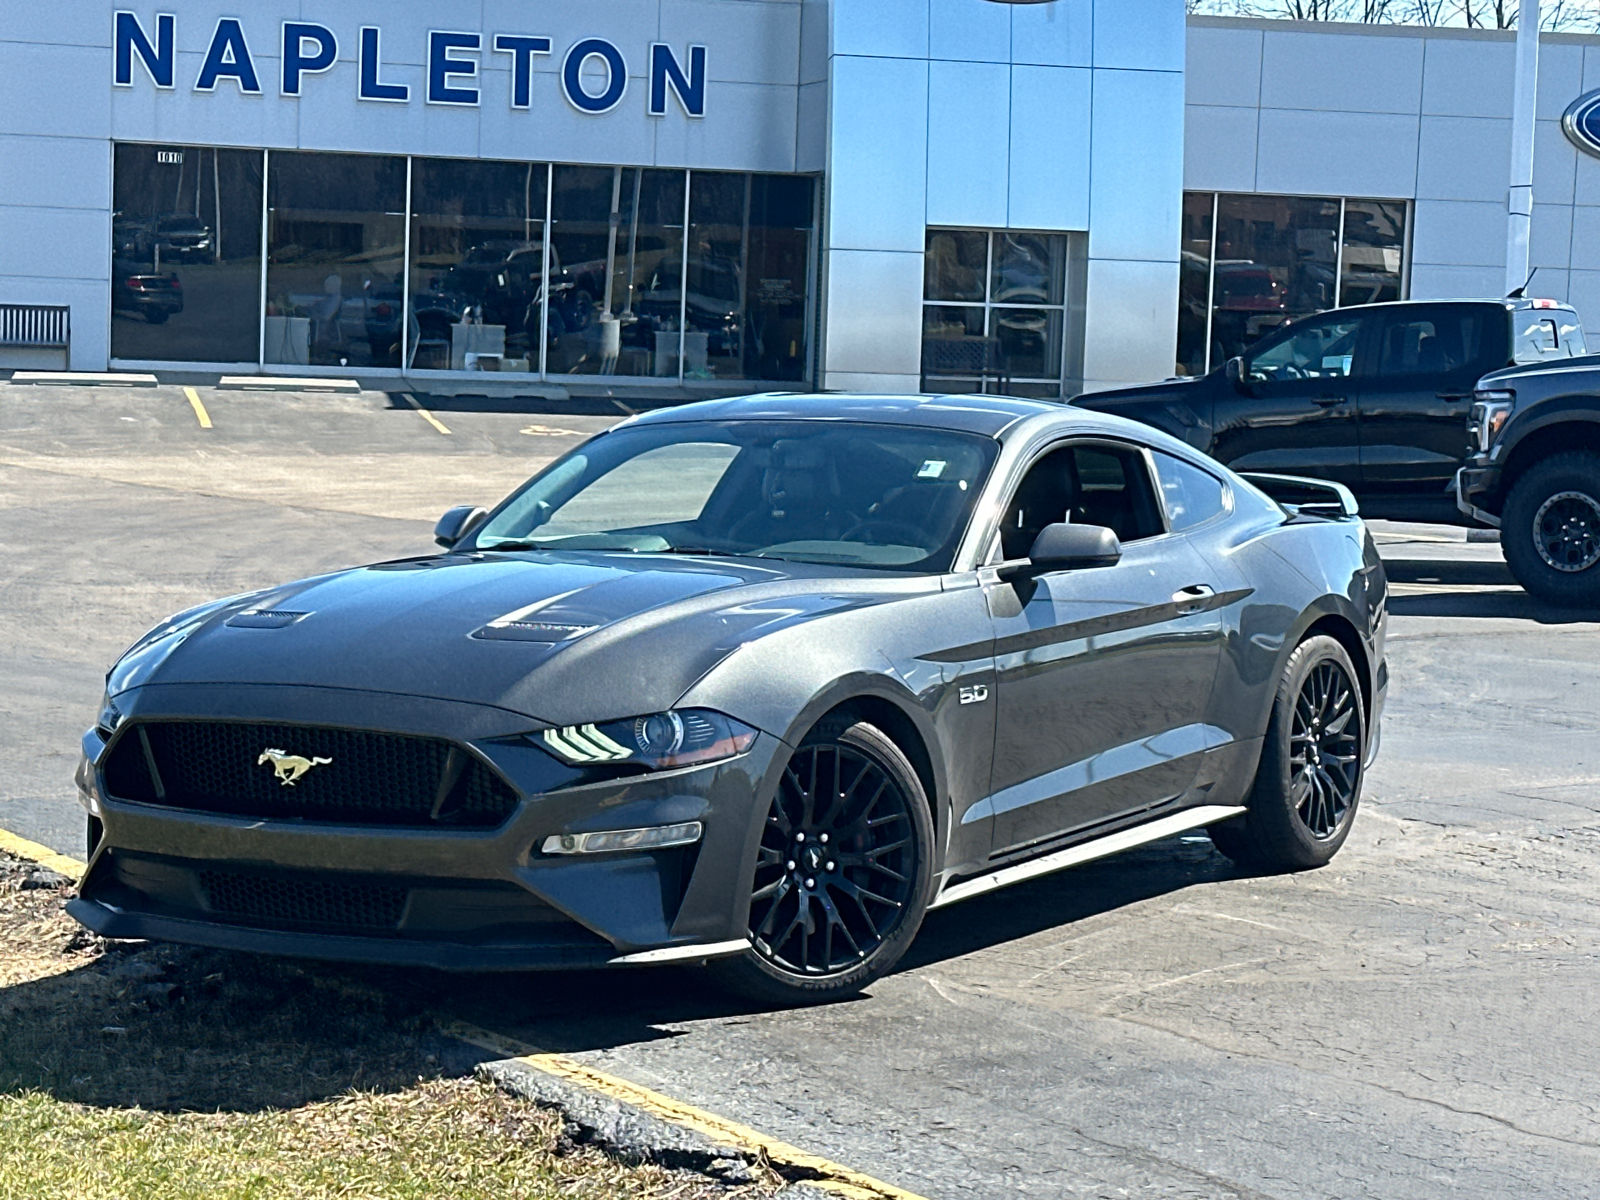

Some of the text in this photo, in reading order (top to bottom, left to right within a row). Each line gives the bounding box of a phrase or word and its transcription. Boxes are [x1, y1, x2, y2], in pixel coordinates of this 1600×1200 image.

[113, 10, 707, 117] NAPLETON
[159, 152, 182, 163] 1010
[959, 684, 988, 704] 5.0
